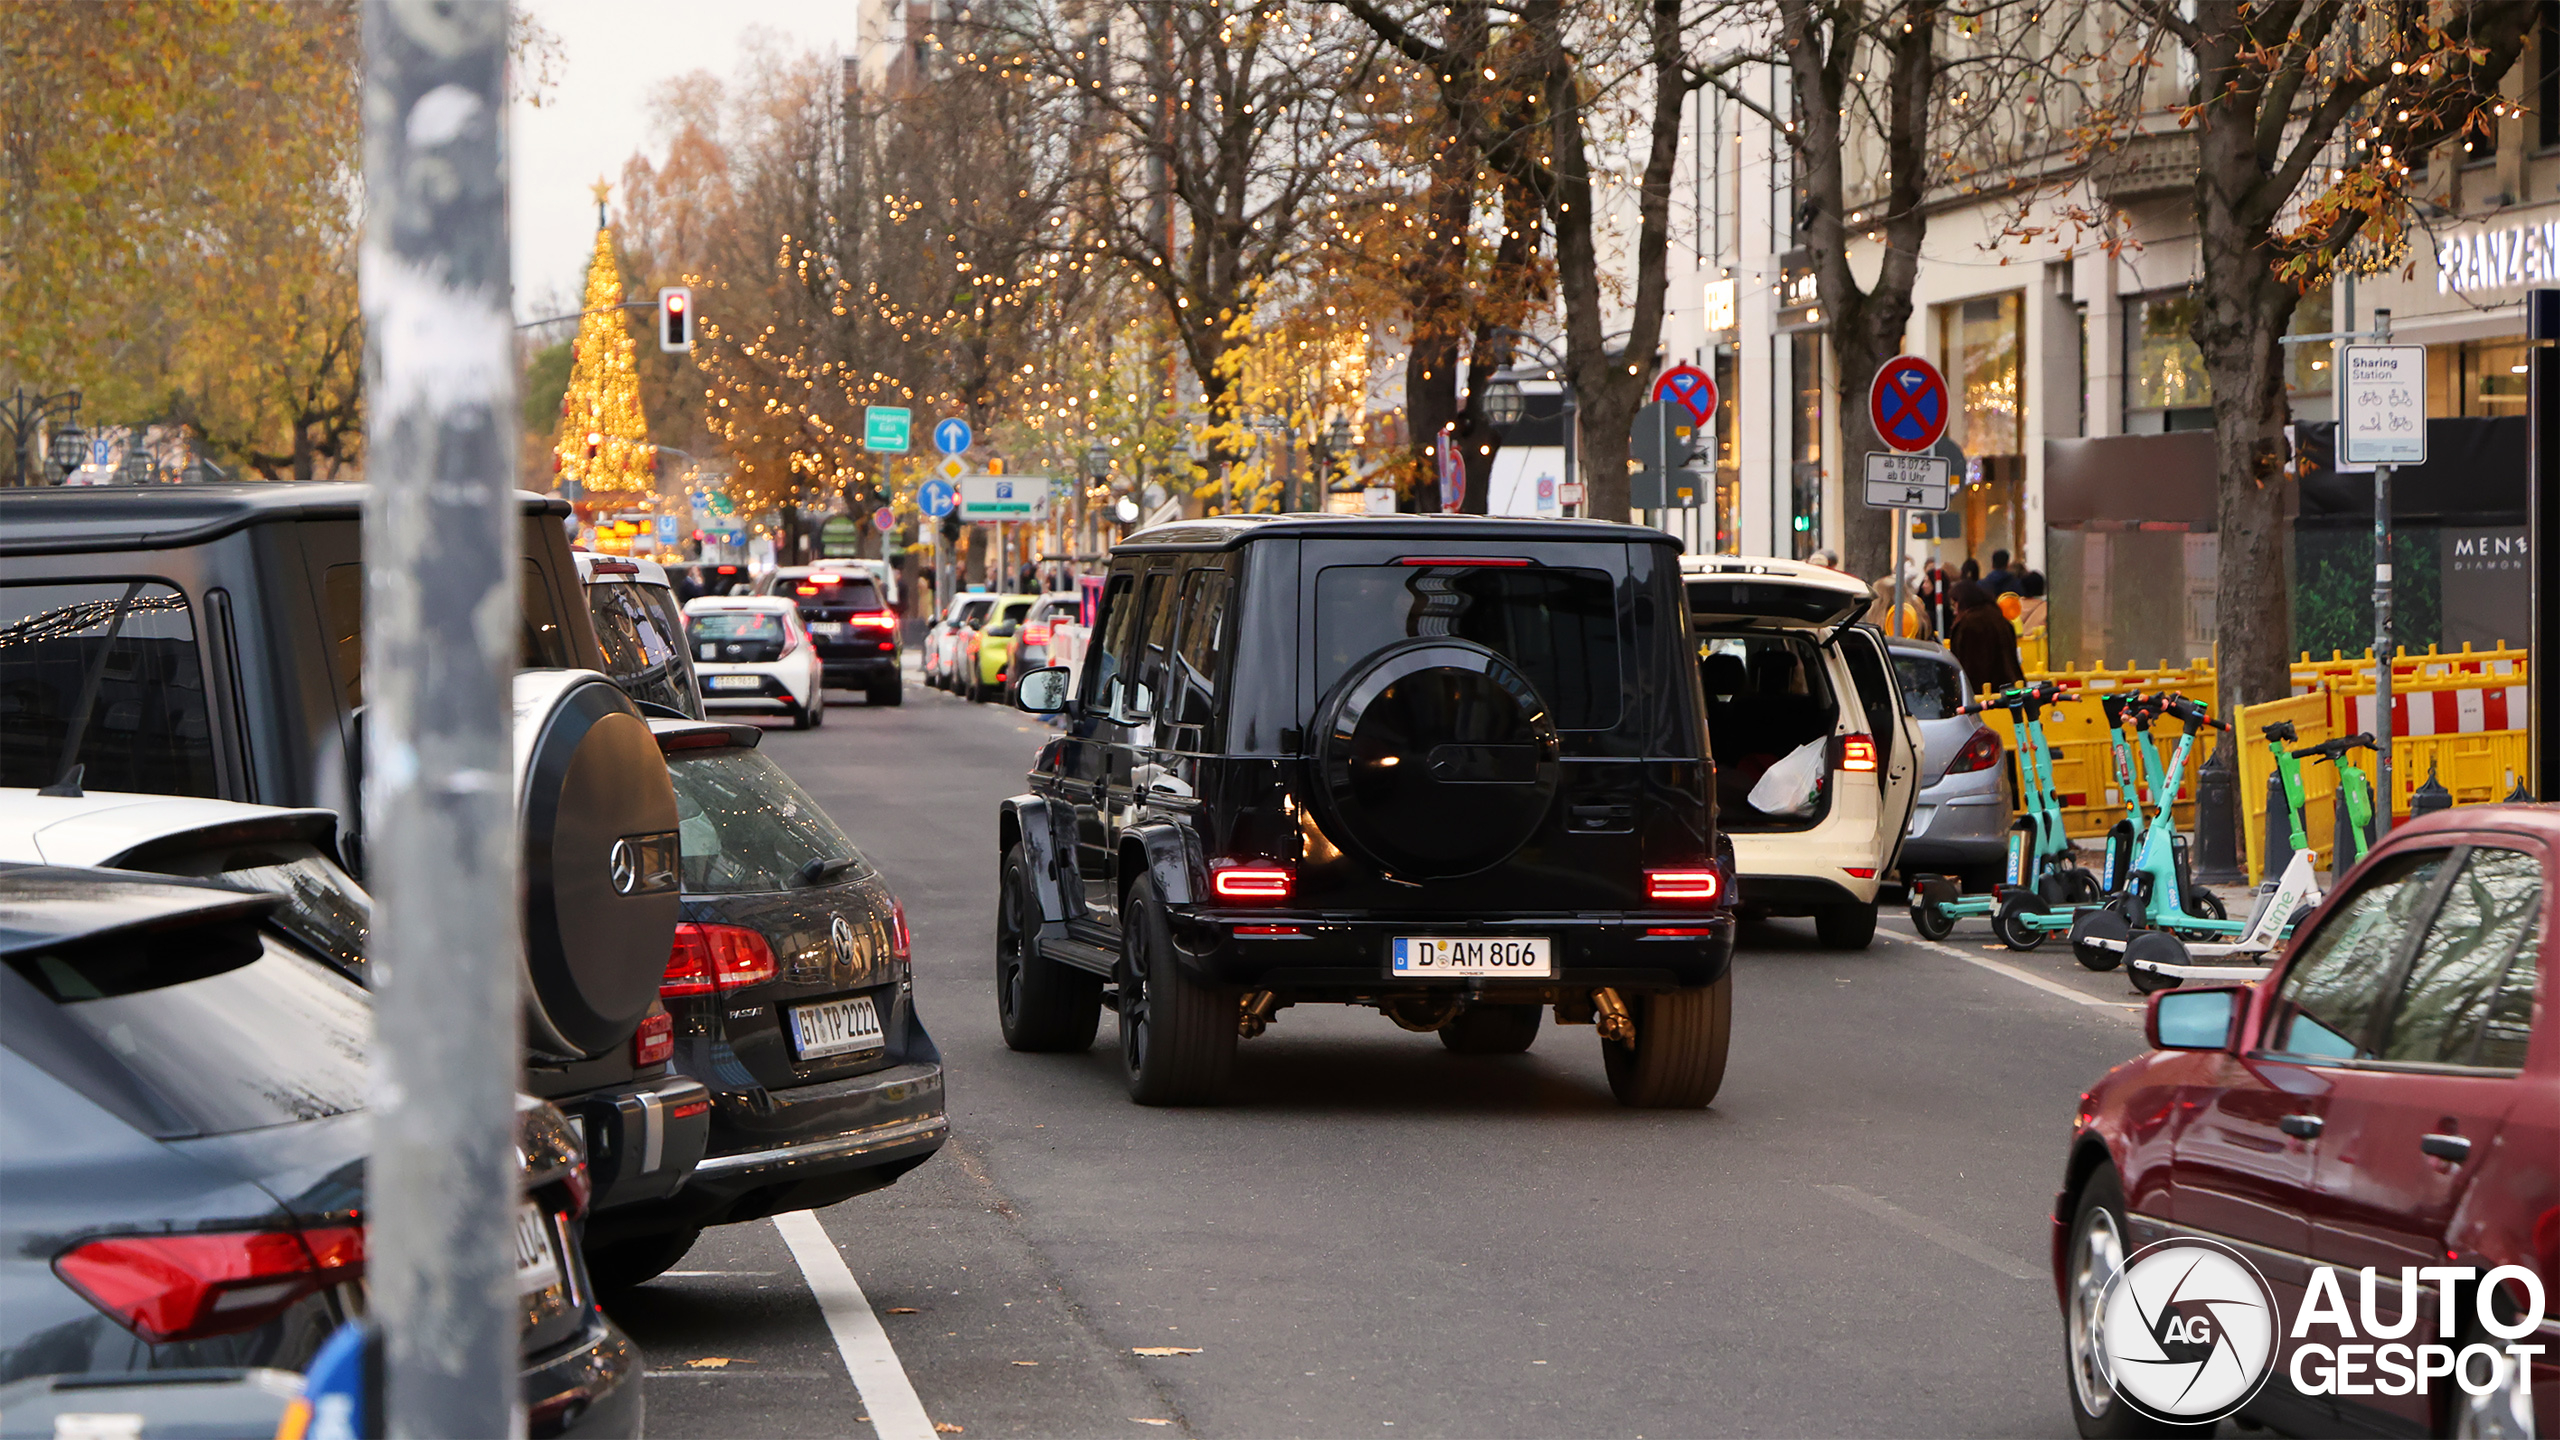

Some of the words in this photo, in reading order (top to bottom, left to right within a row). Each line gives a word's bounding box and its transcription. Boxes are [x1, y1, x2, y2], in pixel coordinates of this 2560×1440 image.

[2437, 222, 2560, 296] FRANZEN
[2353, 358, 2398, 369] Sharing
[2353, 370, 2392, 380] Station
[1884, 458, 1895, 468] ab
[1887, 471, 1898, 481] ab
[1901, 470, 1907, 481] 0
[1909, 471, 1926, 482] Uhr
[2009, 852, 2019, 878] dott
[2105, 853, 2114, 879] dott
[2168, 888, 2179, 908] dott
[2263, 891, 2294, 932] Lime
[1419, 942, 1434, 966] D
[1452, 942, 1483, 966] AM
[1490, 942, 1535, 966] 806
[729, 1006, 764, 1020] PASSAT
[799, 1011, 819, 1046] GT
[823, 1006, 842, 1041] TP
[842, 1001, 879, 1037] 2222
